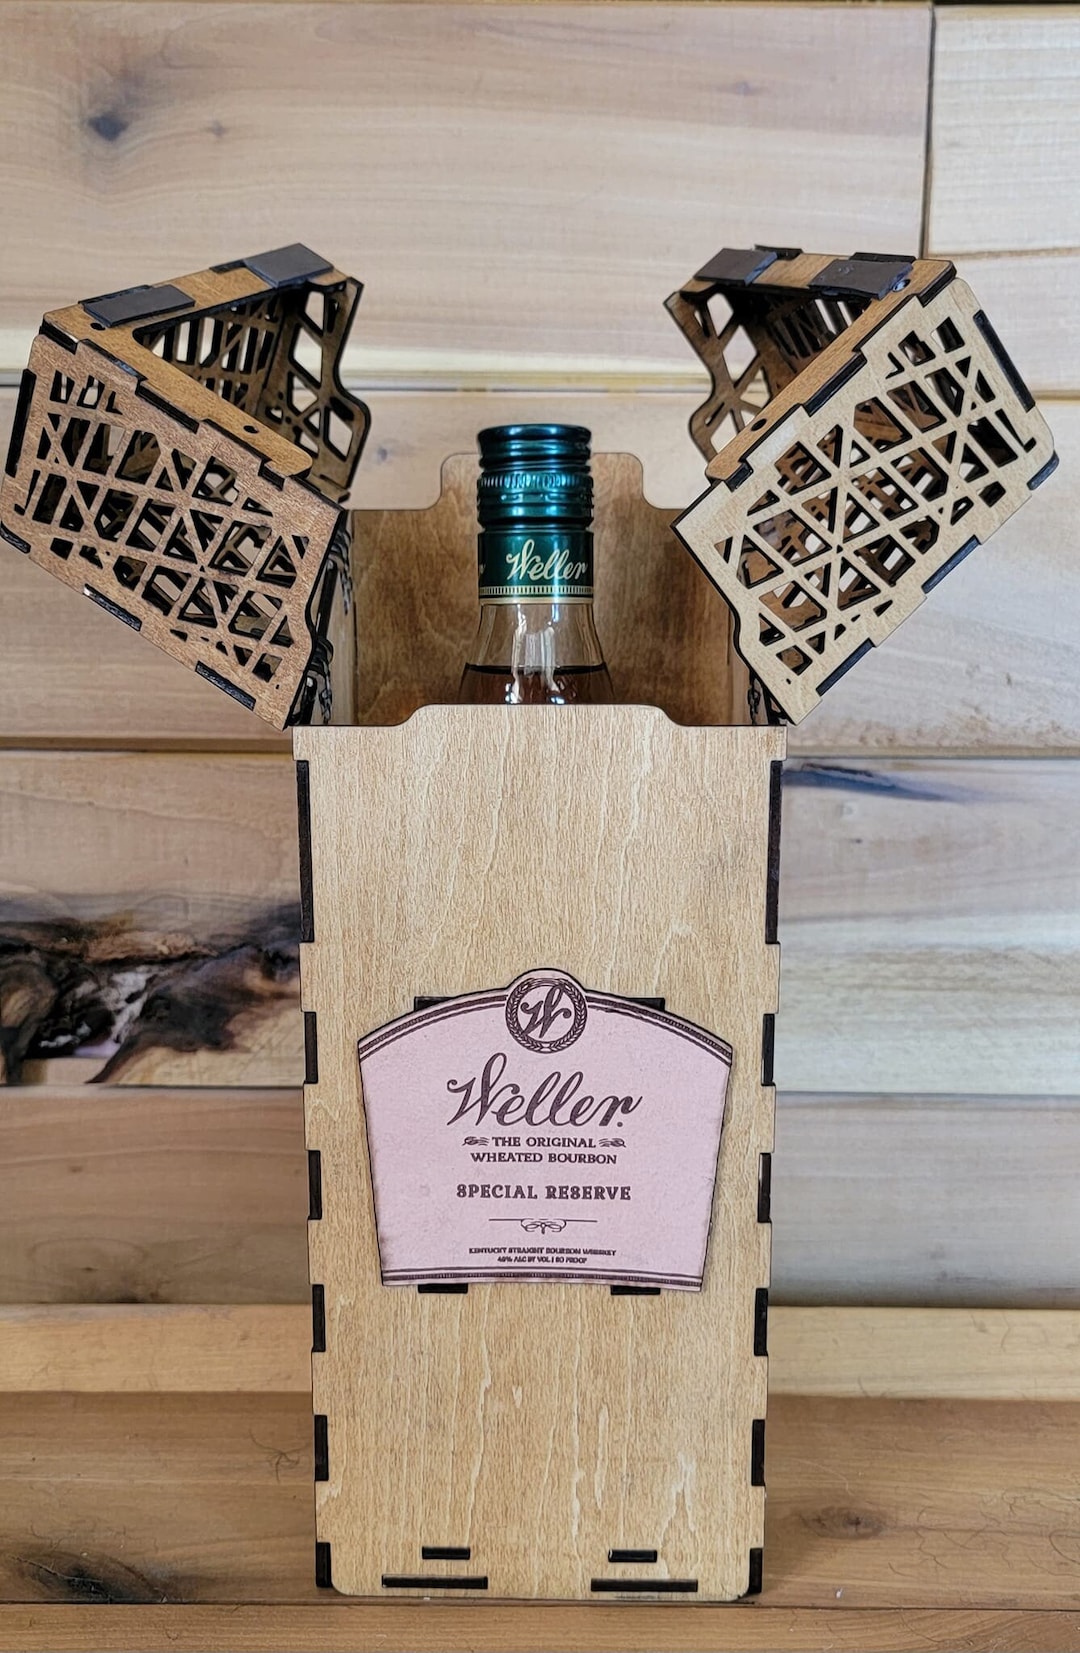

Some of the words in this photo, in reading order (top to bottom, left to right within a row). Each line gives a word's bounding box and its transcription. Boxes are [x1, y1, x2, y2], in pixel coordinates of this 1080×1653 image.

[506, 539, 588, 580] Weller
[492, 1137, 521, 1147] THE
[526, 1137, 596, 1148] ORIGINAL
[470, 1152, 543, 1163] WHEATED
[548, 1153, 617, 1165] BOURBON
[456, 1184, 538, 1199] SPECIAL
[545, 1186, 631, 1200] RESERVE
